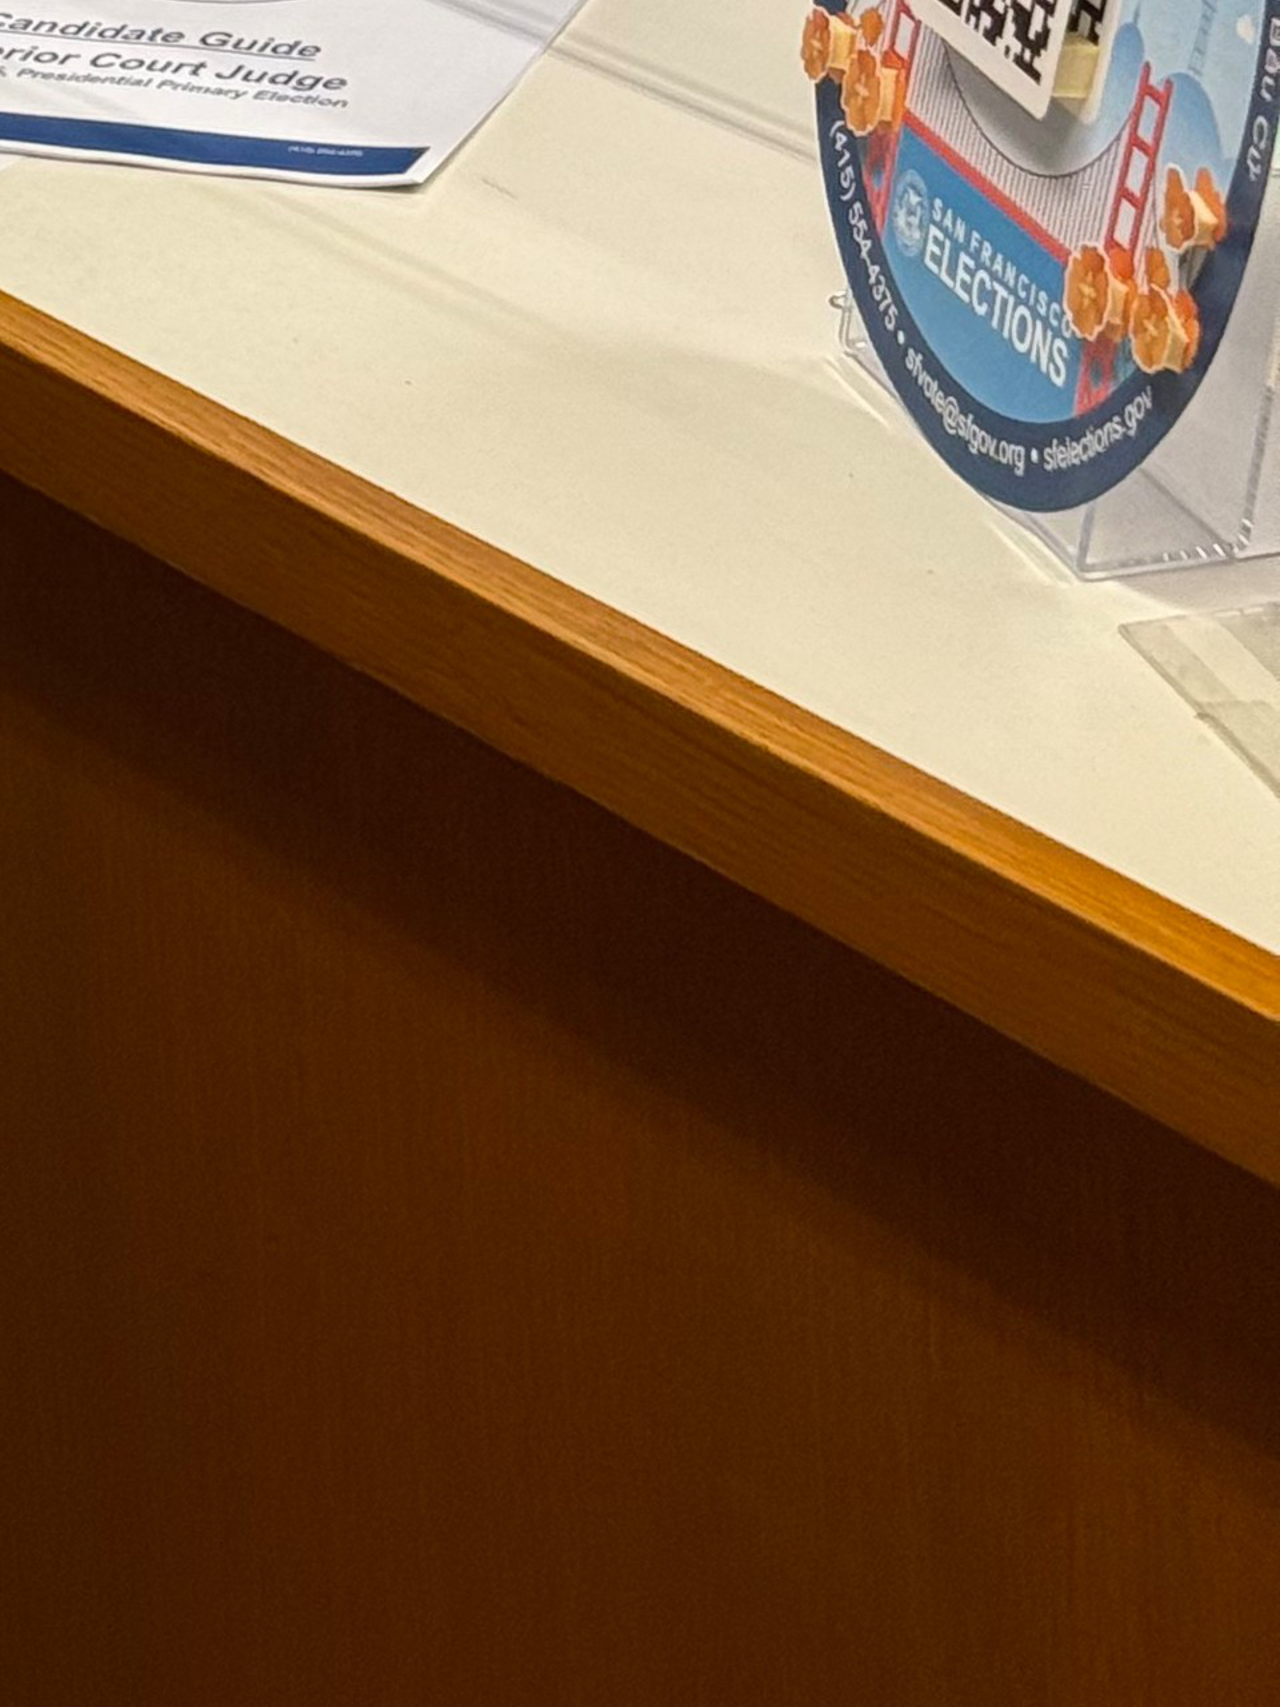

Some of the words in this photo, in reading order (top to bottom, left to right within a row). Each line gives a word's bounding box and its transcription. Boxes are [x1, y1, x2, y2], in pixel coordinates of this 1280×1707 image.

[15, 67, 153, 90] Presidential
[155, 78, 249, 101] Primary
[251, 89, 349, 109] Election
[89, 51, 208, 78] Court
[213, 63, 349, 93] Judge
[198, 30, 323, 58] Guide
[829, 119, 857, 202] (415)
[847, 200, 900, 333] 554-4375
[931, 196, 967, 244] SAN
[969, 229, 1074, 339] FRANCISCO
[923, 222, 1070, 388] ELECTIONS
[904, 346, 1026, 477] sfvote@sfgov.org
[1042, 385, 1154, 473] sfelections.gov
